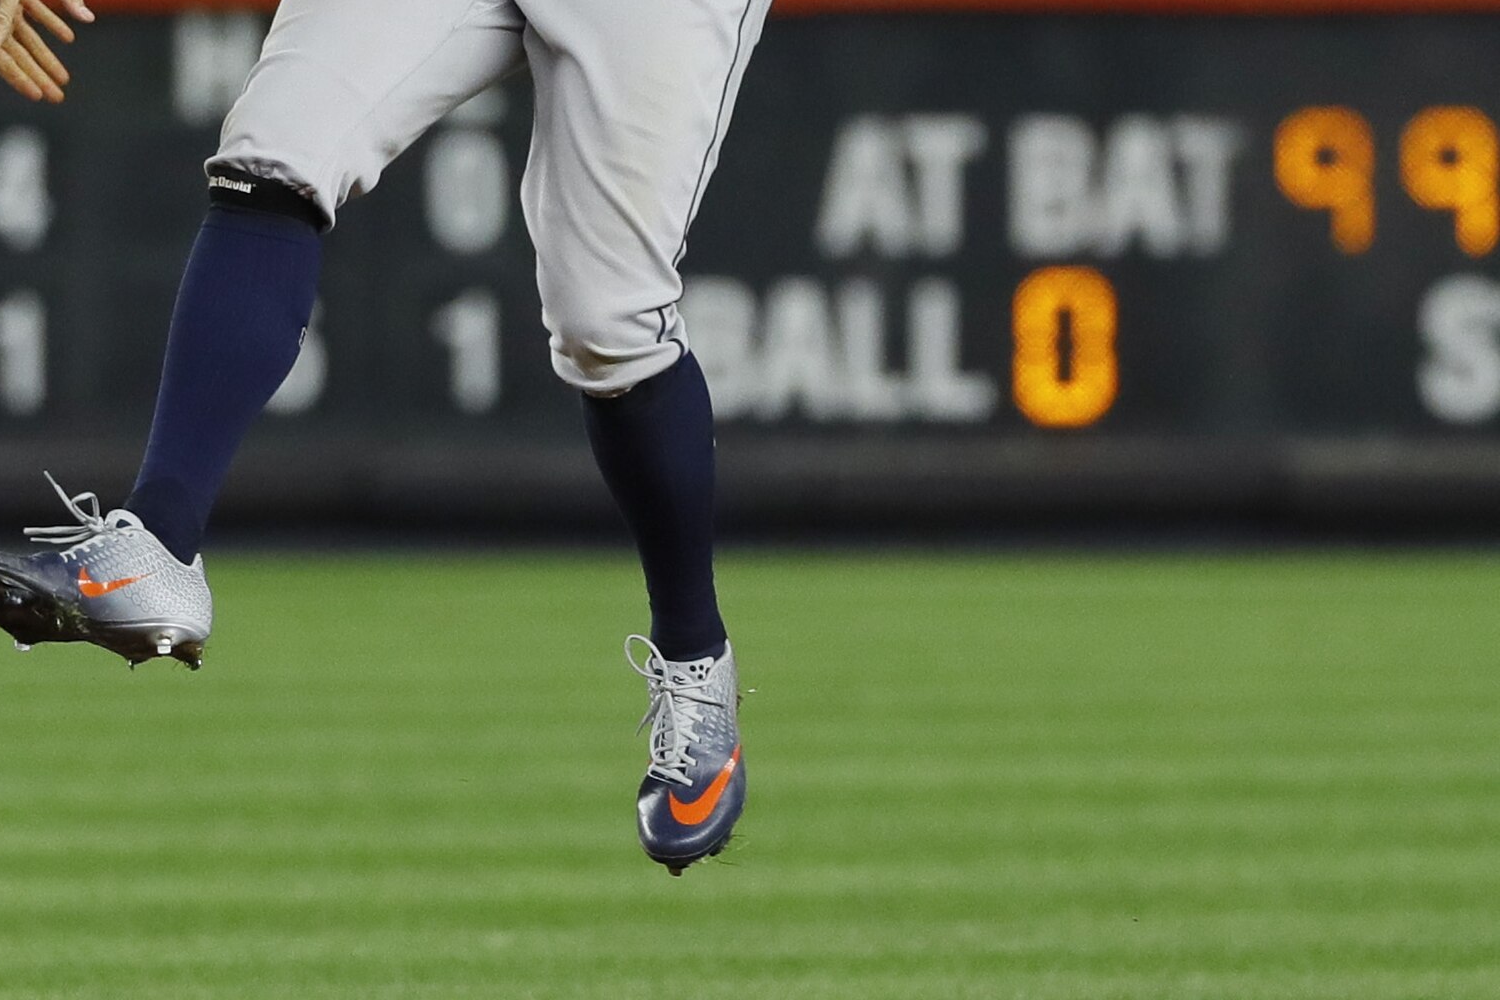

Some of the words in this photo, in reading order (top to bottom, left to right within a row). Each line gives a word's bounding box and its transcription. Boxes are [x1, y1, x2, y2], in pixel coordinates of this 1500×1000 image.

[425, 130, 508, 253] 0
[815, 112, 988, 258] AT
[1007, 112, 1243, 258] BAT
[434, 290, 500, 414] 1
[680, 275, 997, 424] BALL
[1012, 266, 1118, 427] 0
